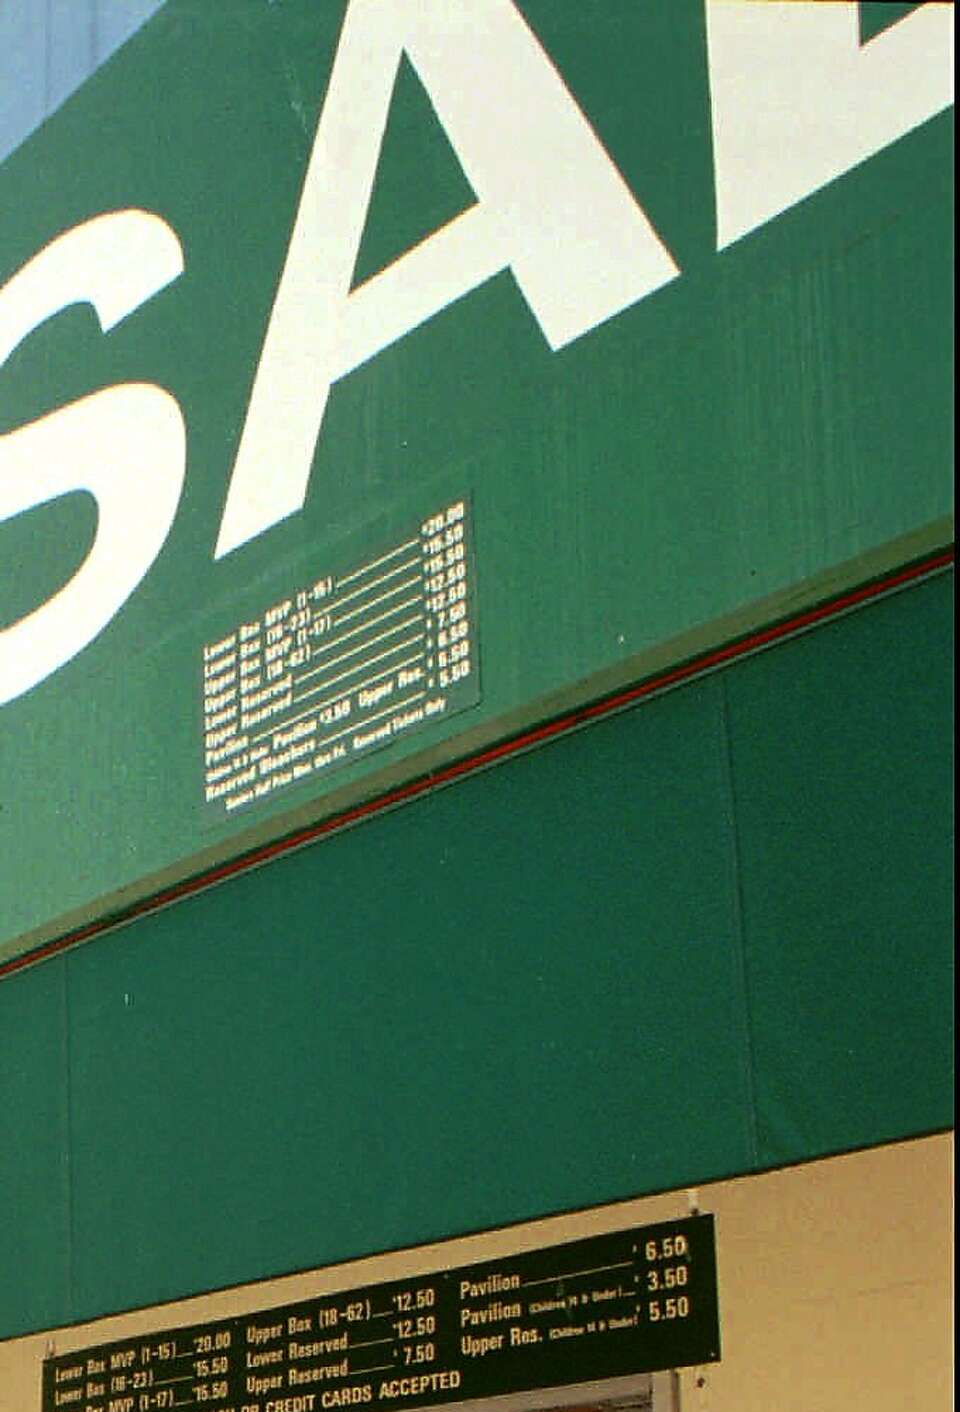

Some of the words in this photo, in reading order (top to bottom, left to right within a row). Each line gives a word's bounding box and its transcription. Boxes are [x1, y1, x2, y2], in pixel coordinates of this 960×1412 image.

[460, 1274, 520, 1299] Pavilion
[461, 1302, 521, 1327] Pavilion
[247, 1324, 282, 1344] Upper
[462, 1334, 503, 1356] Upper
[111, 1351, 136, 1369] MVP
[247, 1349, 283, 1367] Lower
[289, 1332, 348, 1360] Reserved
[247, 1374, 283, 1395] Upper
[289, 1358, 348, 1385] Reserved
[322, 1385, 372, 1408] CARDS
[379, 1371, 460, 1399] ACCEPTED
